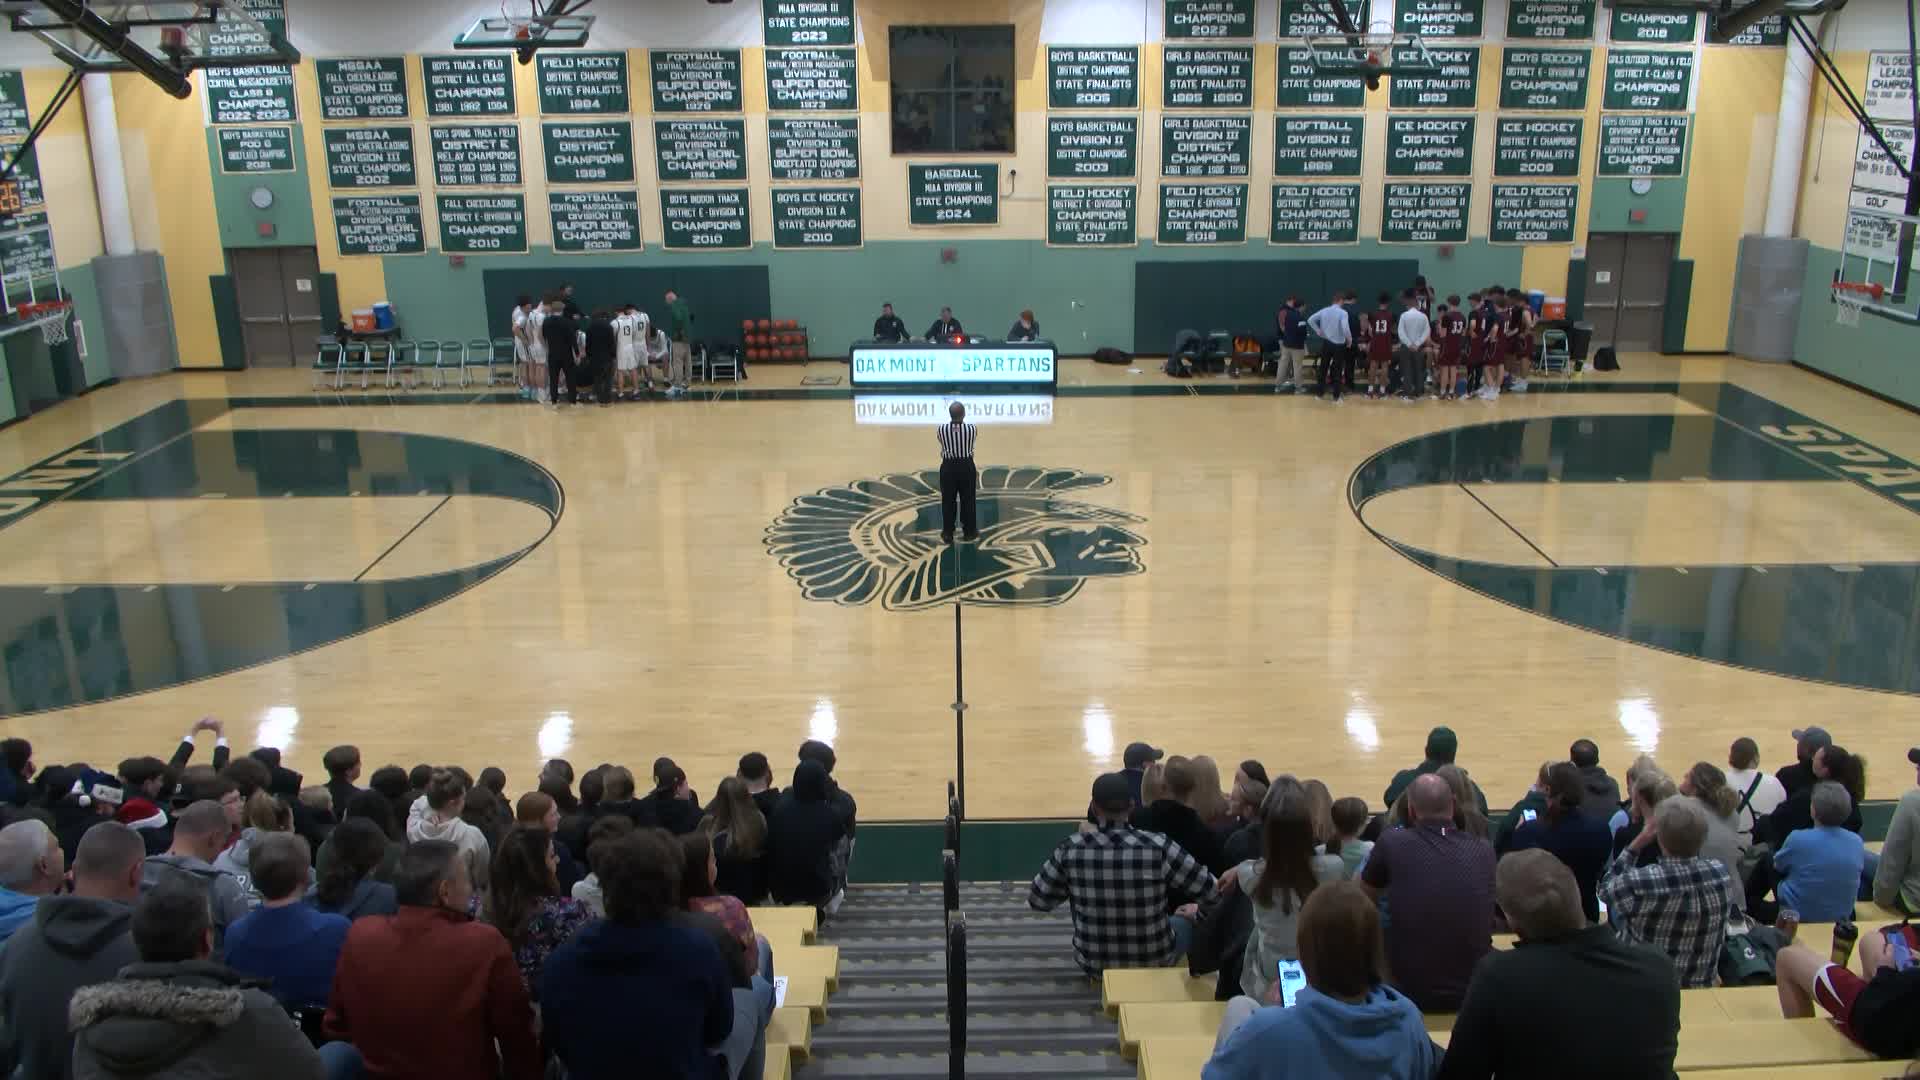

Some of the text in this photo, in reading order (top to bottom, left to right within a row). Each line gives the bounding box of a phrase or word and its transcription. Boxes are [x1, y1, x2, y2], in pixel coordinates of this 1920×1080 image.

[1417, 2, 1451, 10] CLASS
[768, 16, 850, 28] STATE CHAMPIONS
[1174, 13, 1245, 24] CHAMPIONS
[1404, 13, 1474, 23] CHAMPIONS
[1517, 15, 1585, 24] CHAMPIONS
[1620, 13, 1688, 24] CHAMPIONS
[1191, 25, 1227, 35] 2022
[1420, 25, 1455, 34] 2022
[792, 31, 828, 42] 2023
[667, 52, 724, 60] FOOTBALL
[781, 51, 840, 60] FOOTBALL
[1051, 51, 1135, 62] BOYS BASKETBALL
[1166, 51, 1250, 62] GIRLS BASKETBALL
[1511, 53, 1583, 64] BOYS SOCCER
[543, 57, 620, 68] FIELD HOCKEY
[208, 65, 288, 77] BOYS BASKETBALL
[784, 70, 826, 78] DIVISION
[1176, 65, 1227, 76] DIVISION
[208, 78, 236, 87] CENTRAL
[432, 73, 506, 84] DISTRICT ALL CLASS
[772, 79, 852, 88] SUPER BOWL
[1283, 79, 1361, 88] STATE CHAMPIONS
[333, 83, 393, 94] DIVISION III
[657, 81, 736, 90] SUPER BOWL
[1056, 79, 1132, 89] STATE FINALISTS
[1170, 79, 1246, 89] STATE FINALISTS
[1397, 79, 1471, 89] STATE FINALISTS
[1510, 80, 1578, 91] CHAMPIONS
[1614, 82, 1680, 92] CHAMPIONS
[229, 90, 263, 98] CLASS
[435, 87, 505, 98] CHAMPIONS
[545, 85, 623, 96] STATE FINALISTS
[777, 89, 848, 100] CHAMPIONS
[325, 94, 404, 105] STATE CHAMPIONS
[662, 91, 733, 101] CHAMPIONS
[1528, 95, 1558, 105] 2014
[1631, 96, 1660, 106] 2017
[218, 98, 286, 109] CHAMPIONS
[218, 110, 289, 121] 2022-2023
[1051, 122, 1134, 131] BOYS BASKETBALL
[1164, 119, 1248, 129] GIRLS BASKETBALL
[1286, 121, 1353, 130] SOFTBALL
[1394, 121, 1468, 130] ICE HOCKEY
[1503, 123, 1576, 132] ICE HOCKEY
[552, 128, 620, 138] BASEBALL
[1173, 130, 1239, 140] DIVISION III
[1060, 135, 1112, 146] DIVISION
[1288, 134, 1338, 144] DIVISION
[1403, 135, 1458, 144] DISTRICT
[559, 141, 616, 151] DISTRICT
[1178, 142, 1234, 151] DISTRICT
[340, 152, 400, 162] DIVISION III
[662, 150, 740, 160] SUPER BOWL
[776, 149, 854, 158] SUPER BOWL
[1280, 148, 1358, 158] STATE CHAMPIONS
[1395, 148, 1464, 158] CHAMPIONS
[1501, 149, 1575, 159] STATE FINALISTS
[554, 153, 624, 164] CHAMPIONS
[1171, 153, 1241, 164] CHAMPIONS
[1608, 155, 1674, 164] CHAMPIONS
[333, 163, 411, 174] STATE CHAMPIONS
[667, 160, 737, 170] CHAMPIONS
[925, 169, 982, 179] BASEBALL
[356, 175, 390, 185] 2002
[1054, 187, 1130, 198] FIELD HOCKEY
[1166, 187, 1241, 196] FIELD HOCKEY
[1279, 187, 1354, 196] FIELD HOCKEY
[1390, 186, 1465, 196] FIELD HOCKEY
[1498, 187, 1572, 196] FIELD HOCKEY
[916, 195, 992, 206] STATE CHAMPIONS
[1866, 197, 1888, 208] GOLF
[936, 209, 972, 219] 2024
[1057, 210, 1126, 220] CHAMPIONS
[1168, 209, 1238, 219] CHAMPIONS
[1280, 209, 1350, 218] CHAMPIONS
[1392, 209, 1460, 218] CHAMPIONS
[1500, 209, 1567, 218] CHAMPIONS
[449, 224, 517, 235] CHAMPIONS
[671, 220, 741, 231] CHAMPIONS
[778, 220, 856, 230] STATE CHAMPIONS
[1055, 221, 1128, 231] STATE FINALISTS
[1166, 220, 1239, 230] STATE FINALISTS
[1277, 220, 1353, 230] STATE FINALISTS
[1388, 219, 1462, 230] STATE FINALISTS
[1497, 220, 1569, 230] STATE FINALISTS
[346, 234, 416, 244] CHAMPIONS
[562, 231, 631, 241] CHAMPIONS
[692, 234, 723, 244] 2010
[803, 232, 833, 242] 2010
[1077, 233, 1107, 242] 2017
[1299, 231, 1330, 241] 2012
[468, 239, 500, 249] 2010
[856, 358, 936, 373] OAKMONT
[962, 357, 1051, 372] SPARTANS
